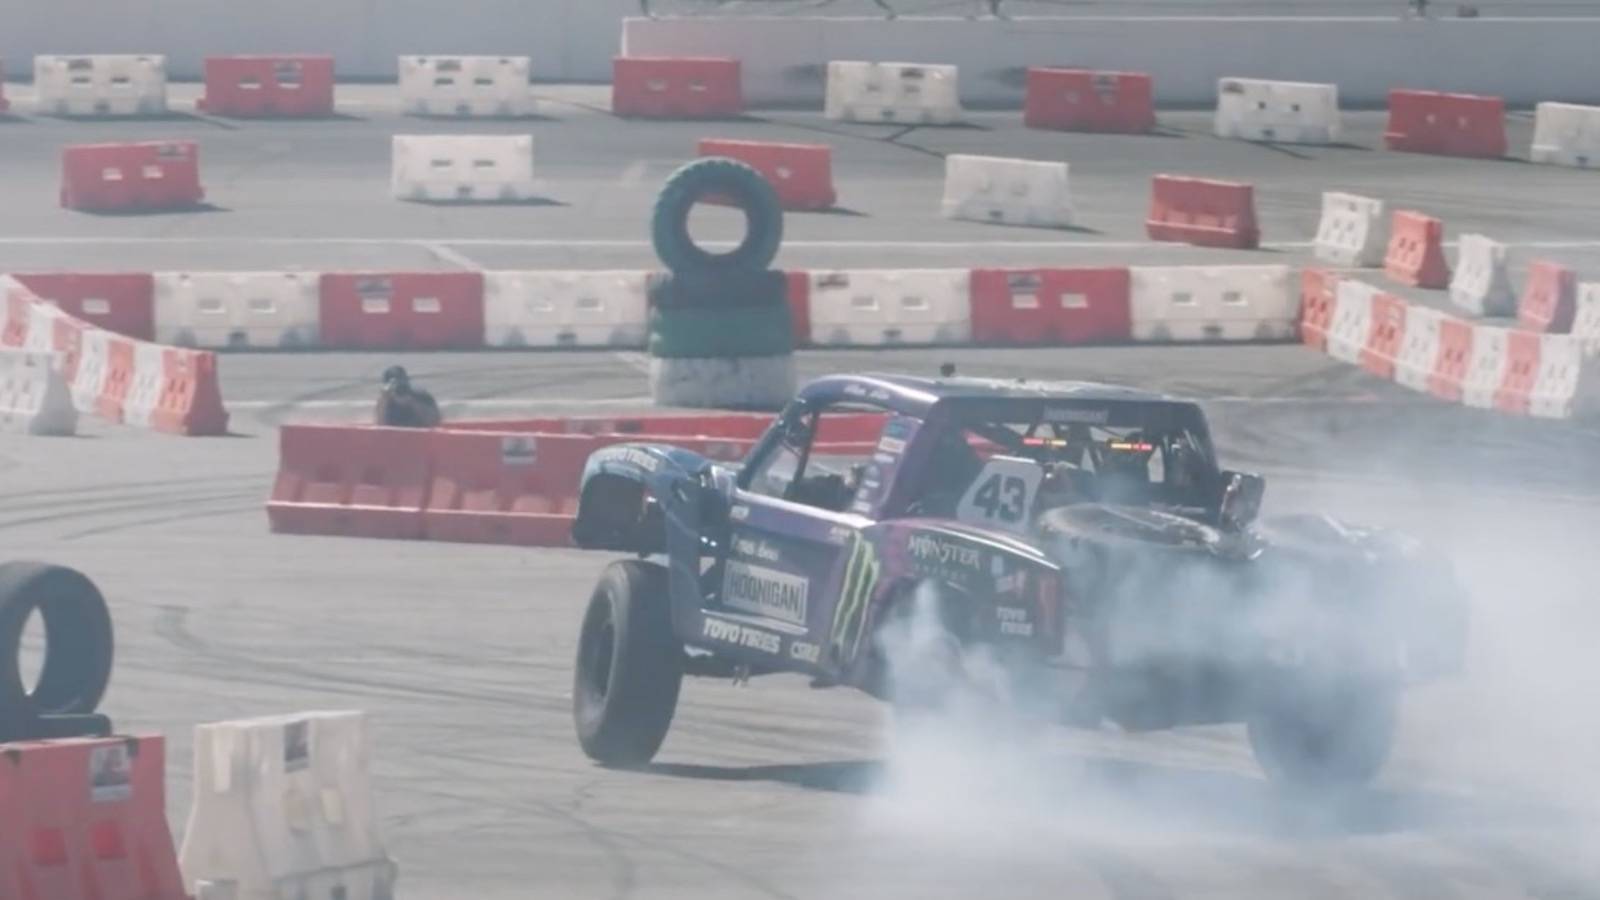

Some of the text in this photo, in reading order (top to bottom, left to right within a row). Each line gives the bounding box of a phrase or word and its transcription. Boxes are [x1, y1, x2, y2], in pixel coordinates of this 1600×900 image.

[973, 472, 1026, 524] 43
[907, 534, 980, 572] MONSTER
[703, 617, 740, 643] TOYO
[739, 626, 781, 655] TIRES
